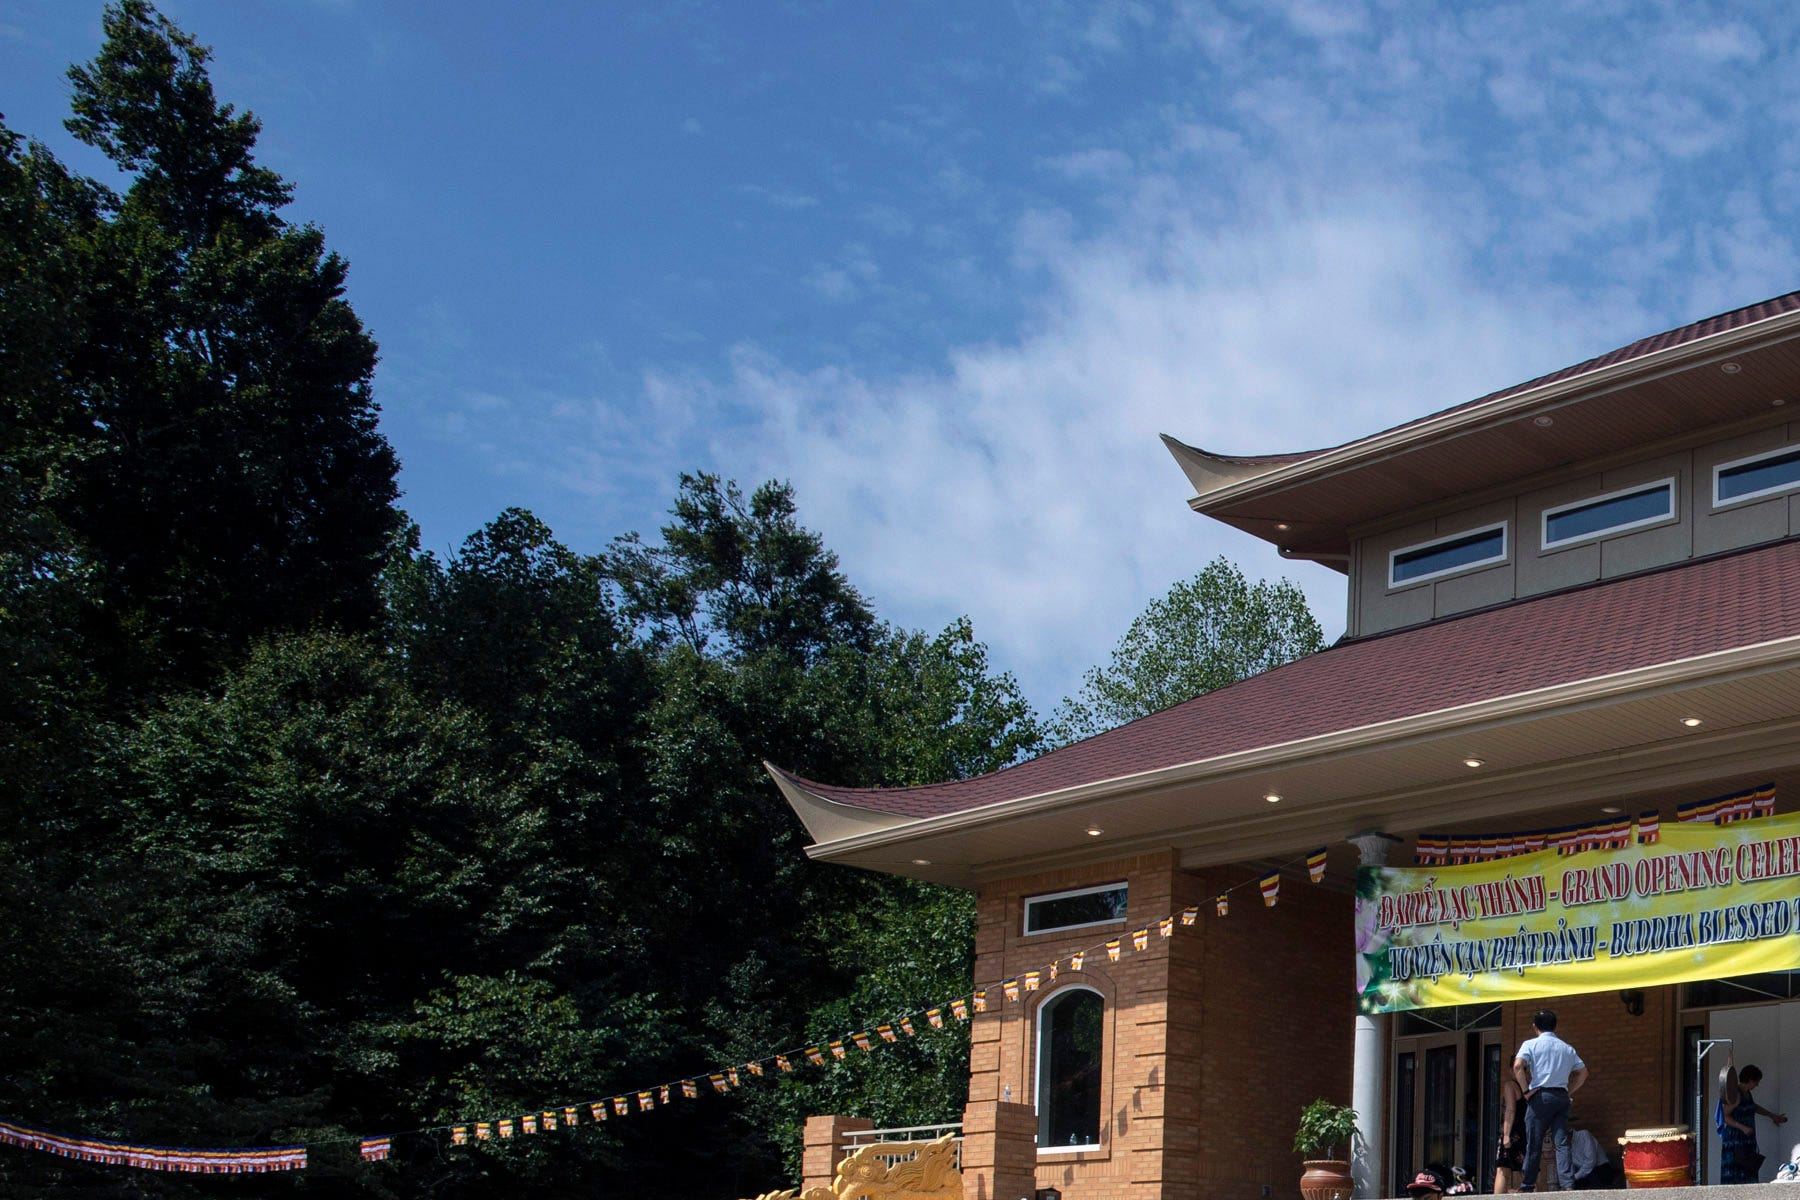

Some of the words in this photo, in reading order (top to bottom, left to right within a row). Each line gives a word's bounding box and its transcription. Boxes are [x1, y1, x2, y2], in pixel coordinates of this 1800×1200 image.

[1437, 887, 1476, 929] LẠC
[1561, 861, 1631, 906] GRAND
[1634, 846, 1732, 897] OPENING
[1413, 931, 1454, 984] VIỆN
[1454, 938, 1490, 980] VẠN
[1490, 924, 1540, 976] PHẬT
[1609, 912, 1695, 957] BUDDHA
[1697, 899, 1791, 946] BLESSED
